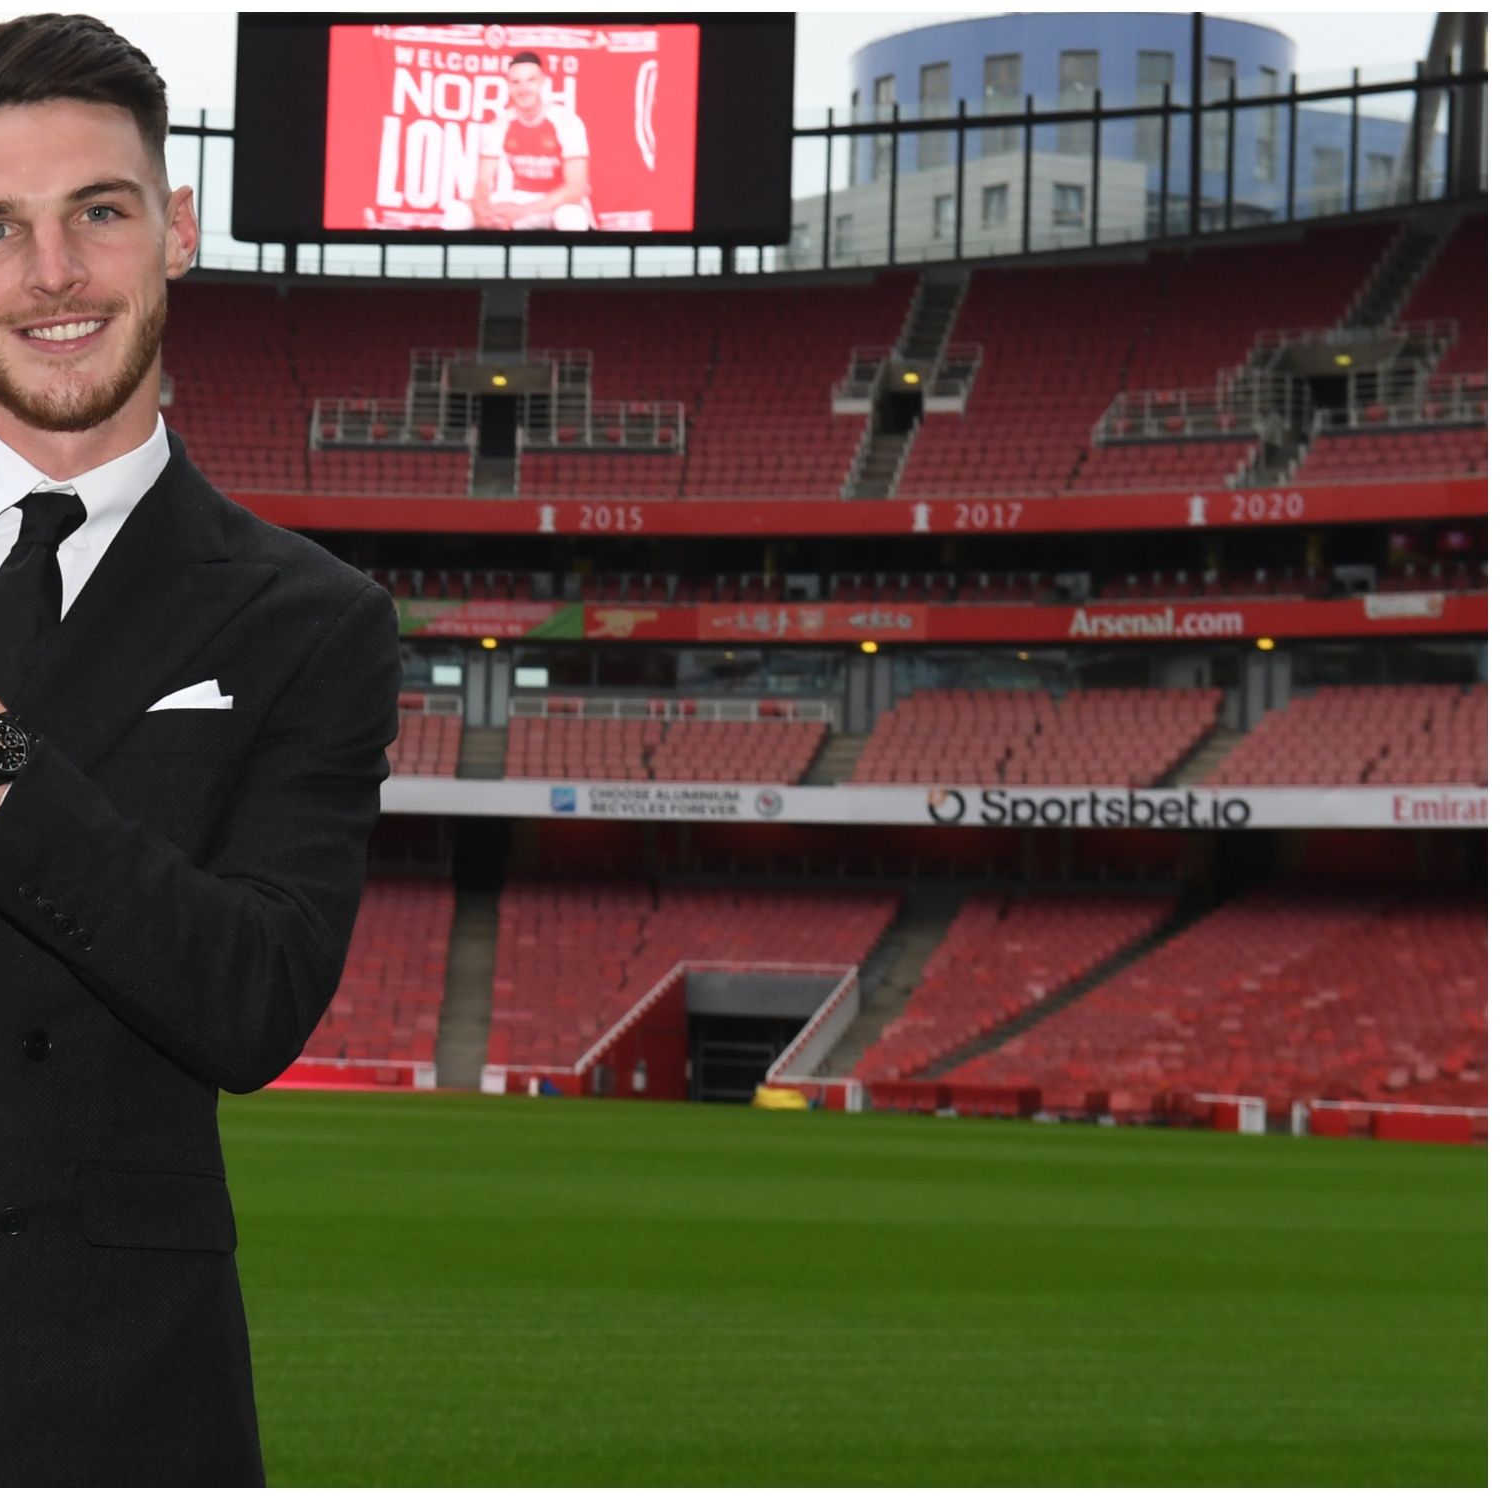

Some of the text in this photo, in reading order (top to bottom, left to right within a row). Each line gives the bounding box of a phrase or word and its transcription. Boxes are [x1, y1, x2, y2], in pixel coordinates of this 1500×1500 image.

[547, 55, 579, 75] TO
[393, 67, 577, 121] NORH
[579, 505, 644, 532] 2015
[954, 502, 1024, 530] 2017
[1230, 491, 1305, 521] 2020
[1068, 606, 1244, 638] Arsenal.com
[588, 786, 650, 801] CHOOSE
[589, 801, 666, 815] RECYCLES
[980, 788, 1253, 828] Sportsbet.io
